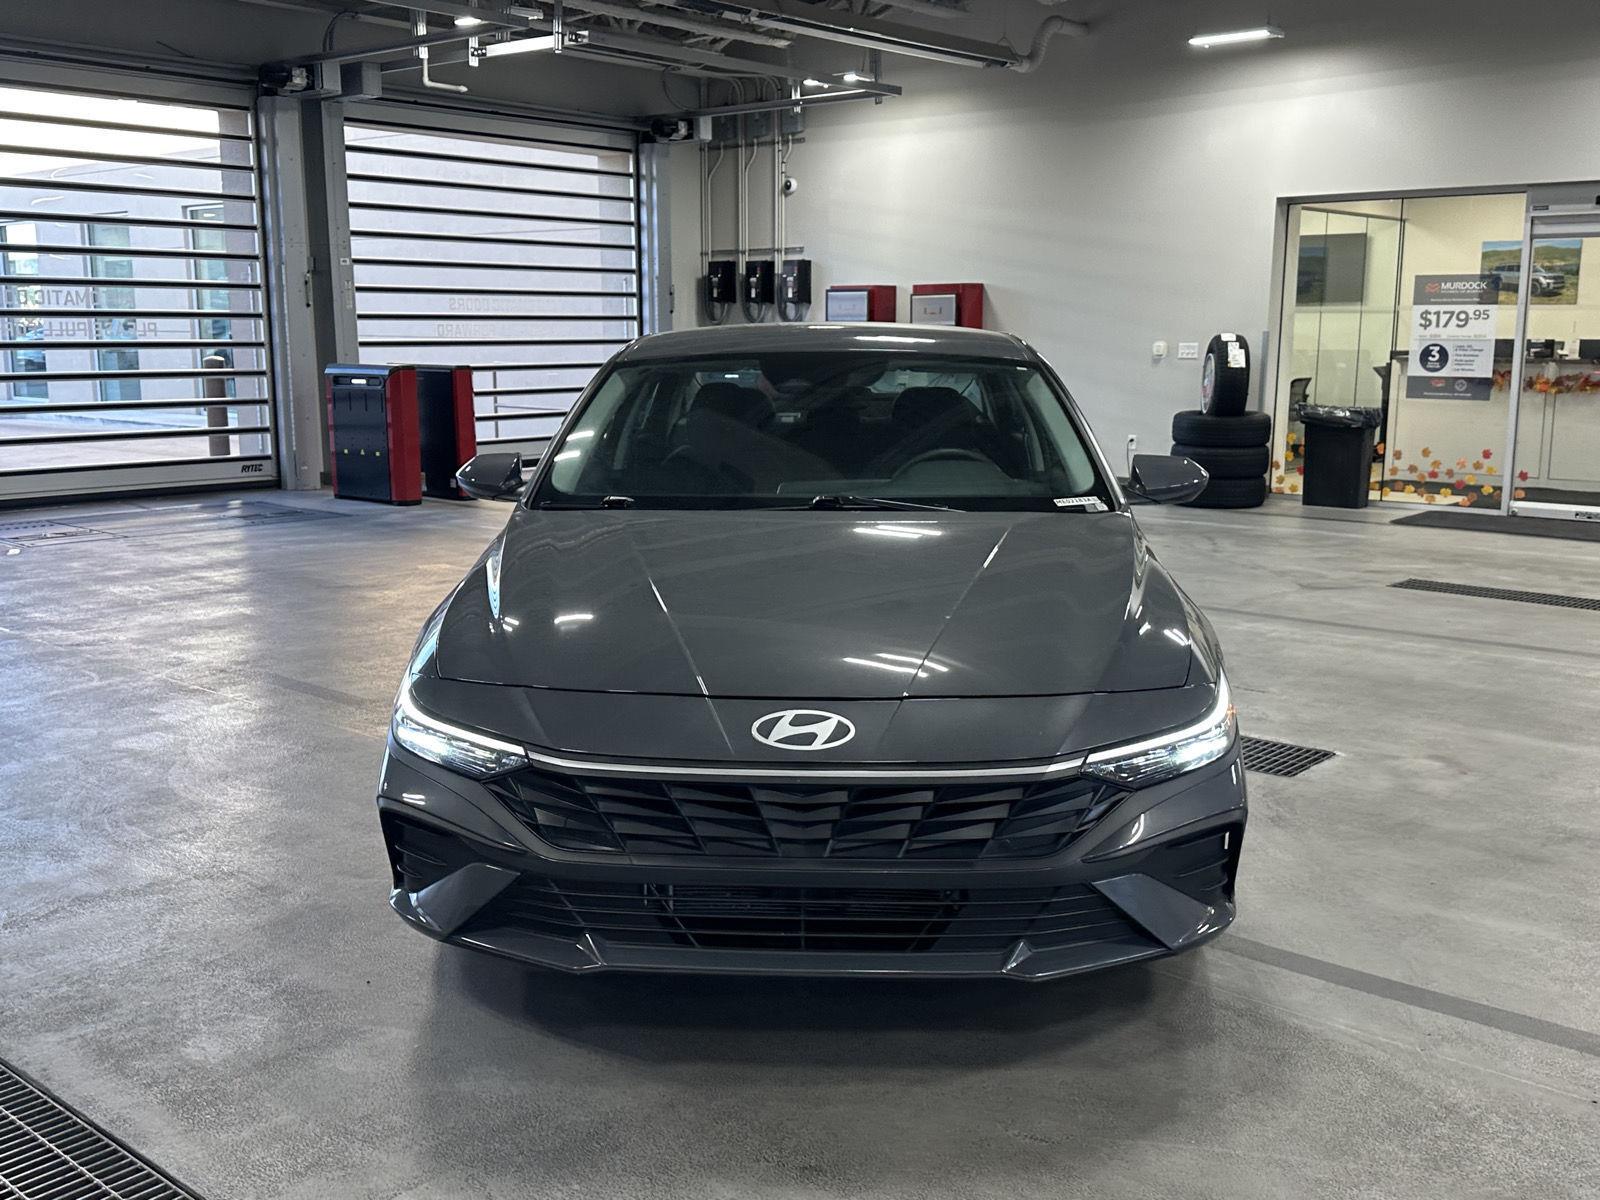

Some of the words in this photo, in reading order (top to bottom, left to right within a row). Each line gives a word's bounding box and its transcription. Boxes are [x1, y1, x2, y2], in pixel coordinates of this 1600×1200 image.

[1441, 281, 1487, 290] MURDOCK
[1419, 309, 1490, 330] $179.95
[1428, 346, 1440, 361] 3
